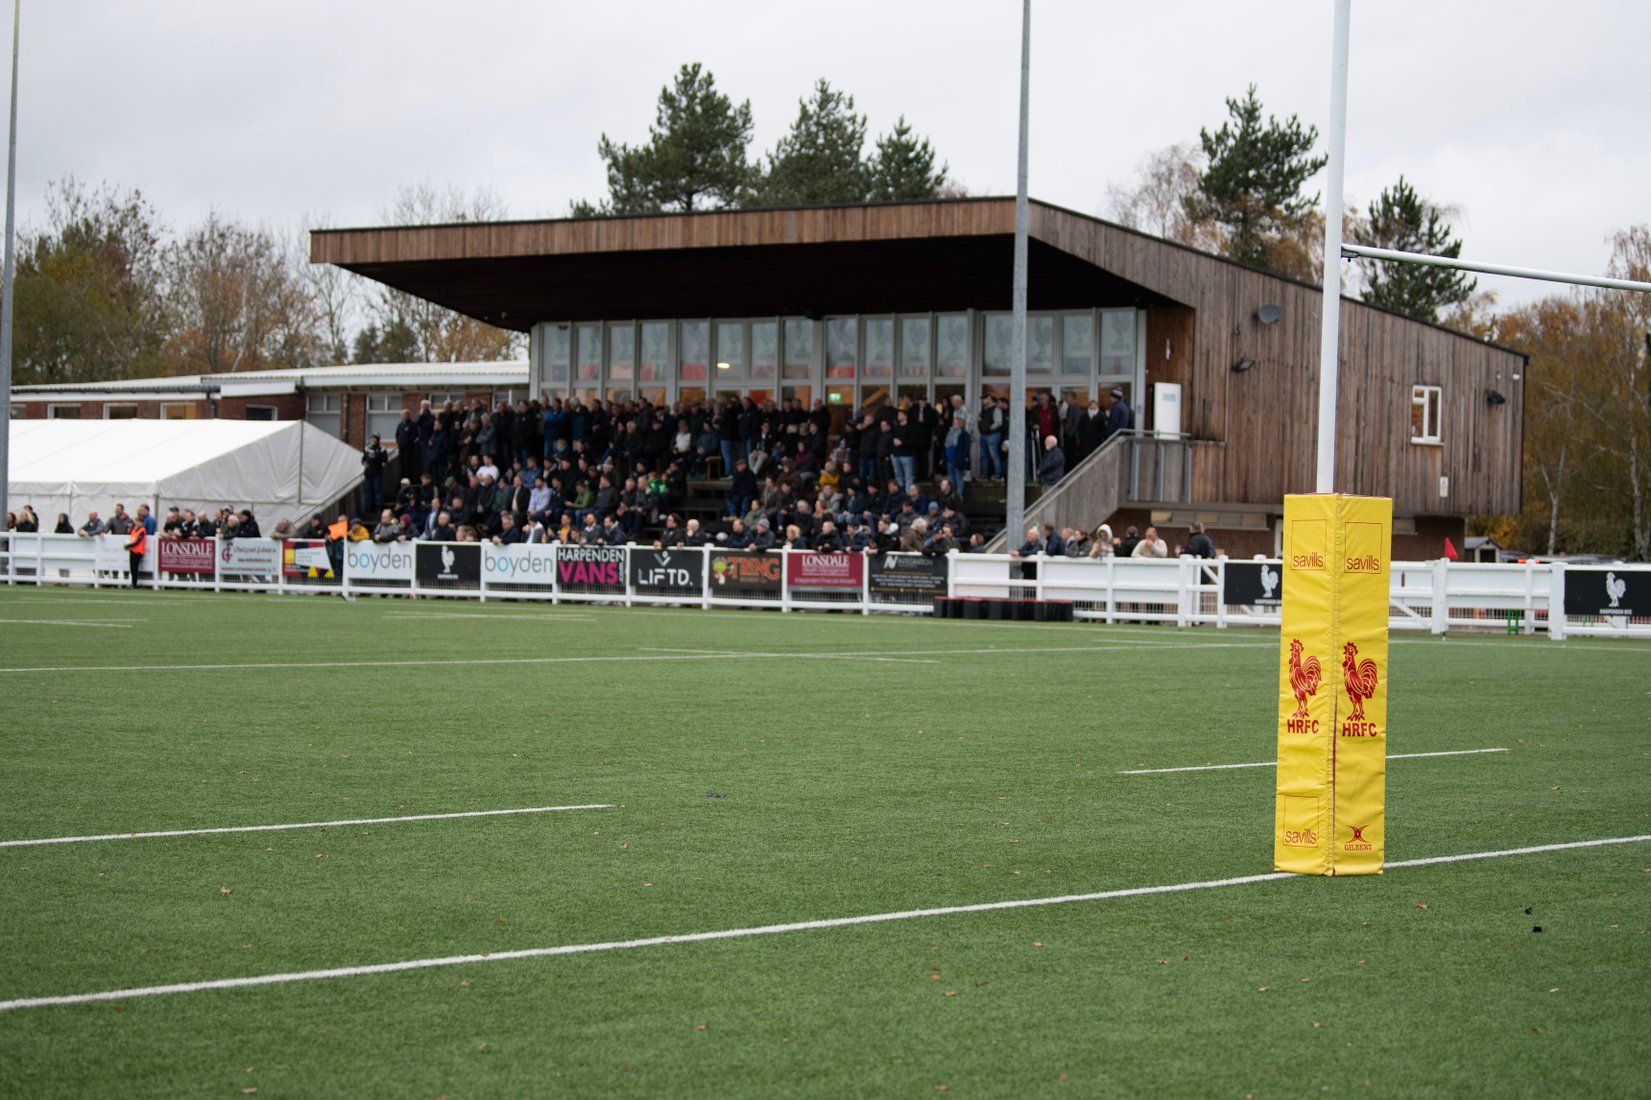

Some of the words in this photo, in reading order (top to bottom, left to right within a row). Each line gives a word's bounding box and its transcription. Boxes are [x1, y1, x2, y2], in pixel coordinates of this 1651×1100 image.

[161, 541, 213, 556] LONSDALE
[557, 549, 625, 562] HARPENDEN
[348, 546, 412, 574] boyden
[484, 550, 553, 578] boyden
[727, 556, 780, 580] TRING
[802, 555, 850, 566] LONSDALE
[1293, 552, 1324, 568] savills
[1346, 555, 1380, 571] savills
[558, 561, 619, 584] VANS
[638, 568, 693, 586] LIFTD.
[1287, 719, 1320, 734] HRFC
[1342, 722, 1377, 737] HRFC
[1285, 828, 1317, 845] savills
